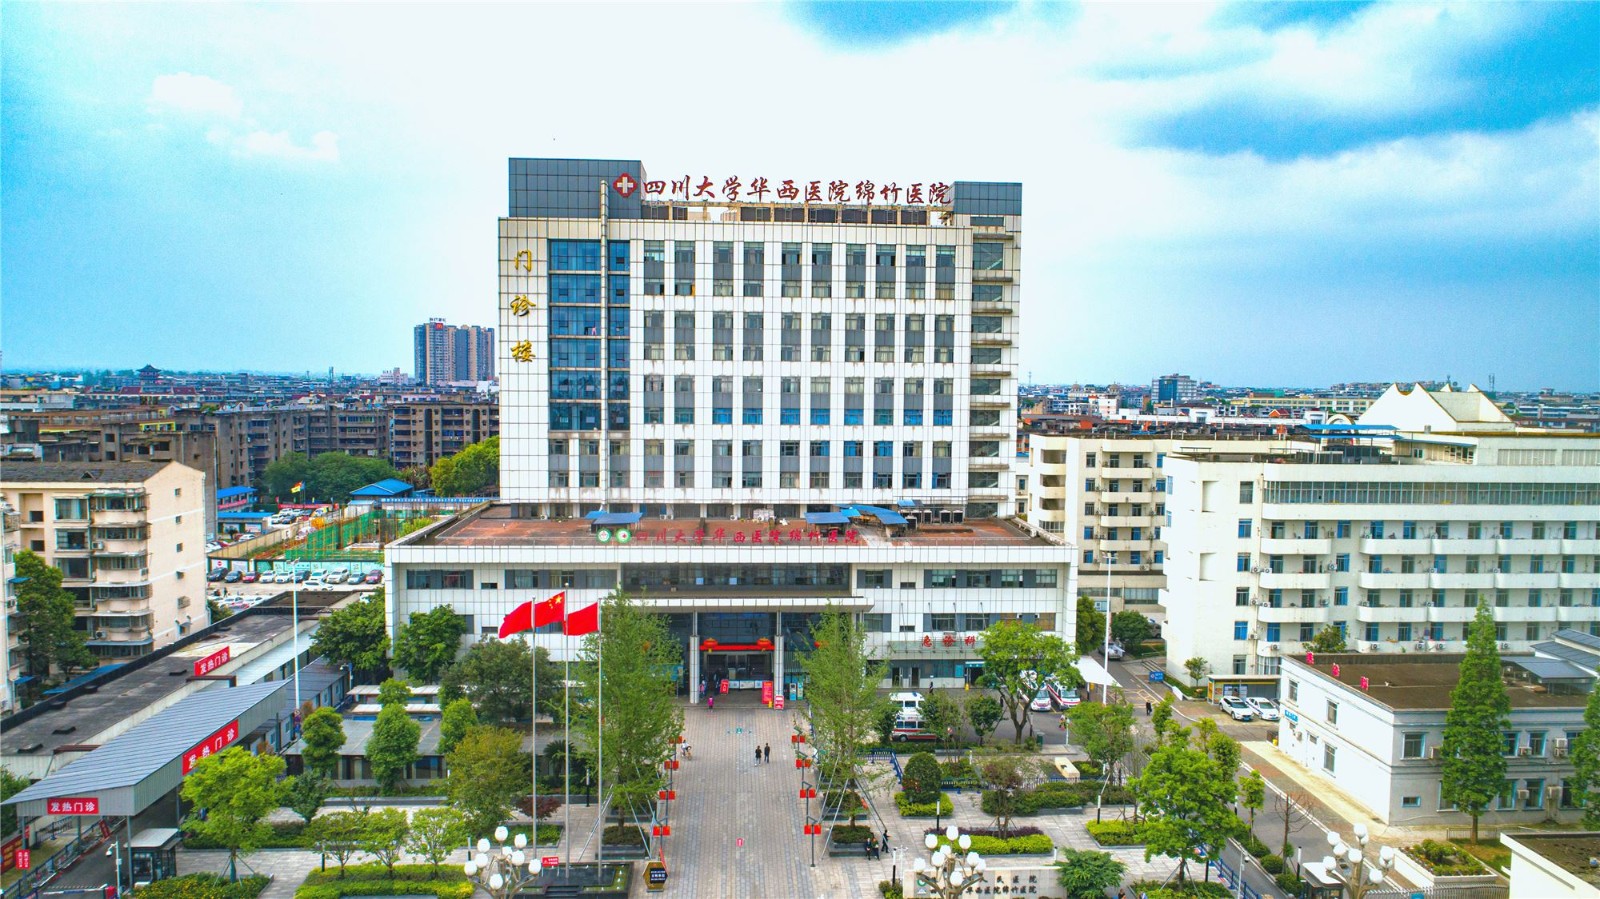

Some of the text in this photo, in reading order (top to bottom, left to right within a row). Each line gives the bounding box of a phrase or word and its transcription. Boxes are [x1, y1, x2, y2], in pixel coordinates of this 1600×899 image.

[643, 174, 953, 206] 四川大学华西医院绵竹医院
[510, 249, 537, 363] 门诊楼
[635, 527, 860, 545] 四川大学华西医院绵竹医院
[922, 634, 976, 648] 急诊科
[200, 652, 229, 674] 发热门诊
[188, 728, 236, 769] 发热门诊
[50, 801, 96, 812] 发热门诊
[930, 885, 1037, 895] 四华西医院绵竹医院
